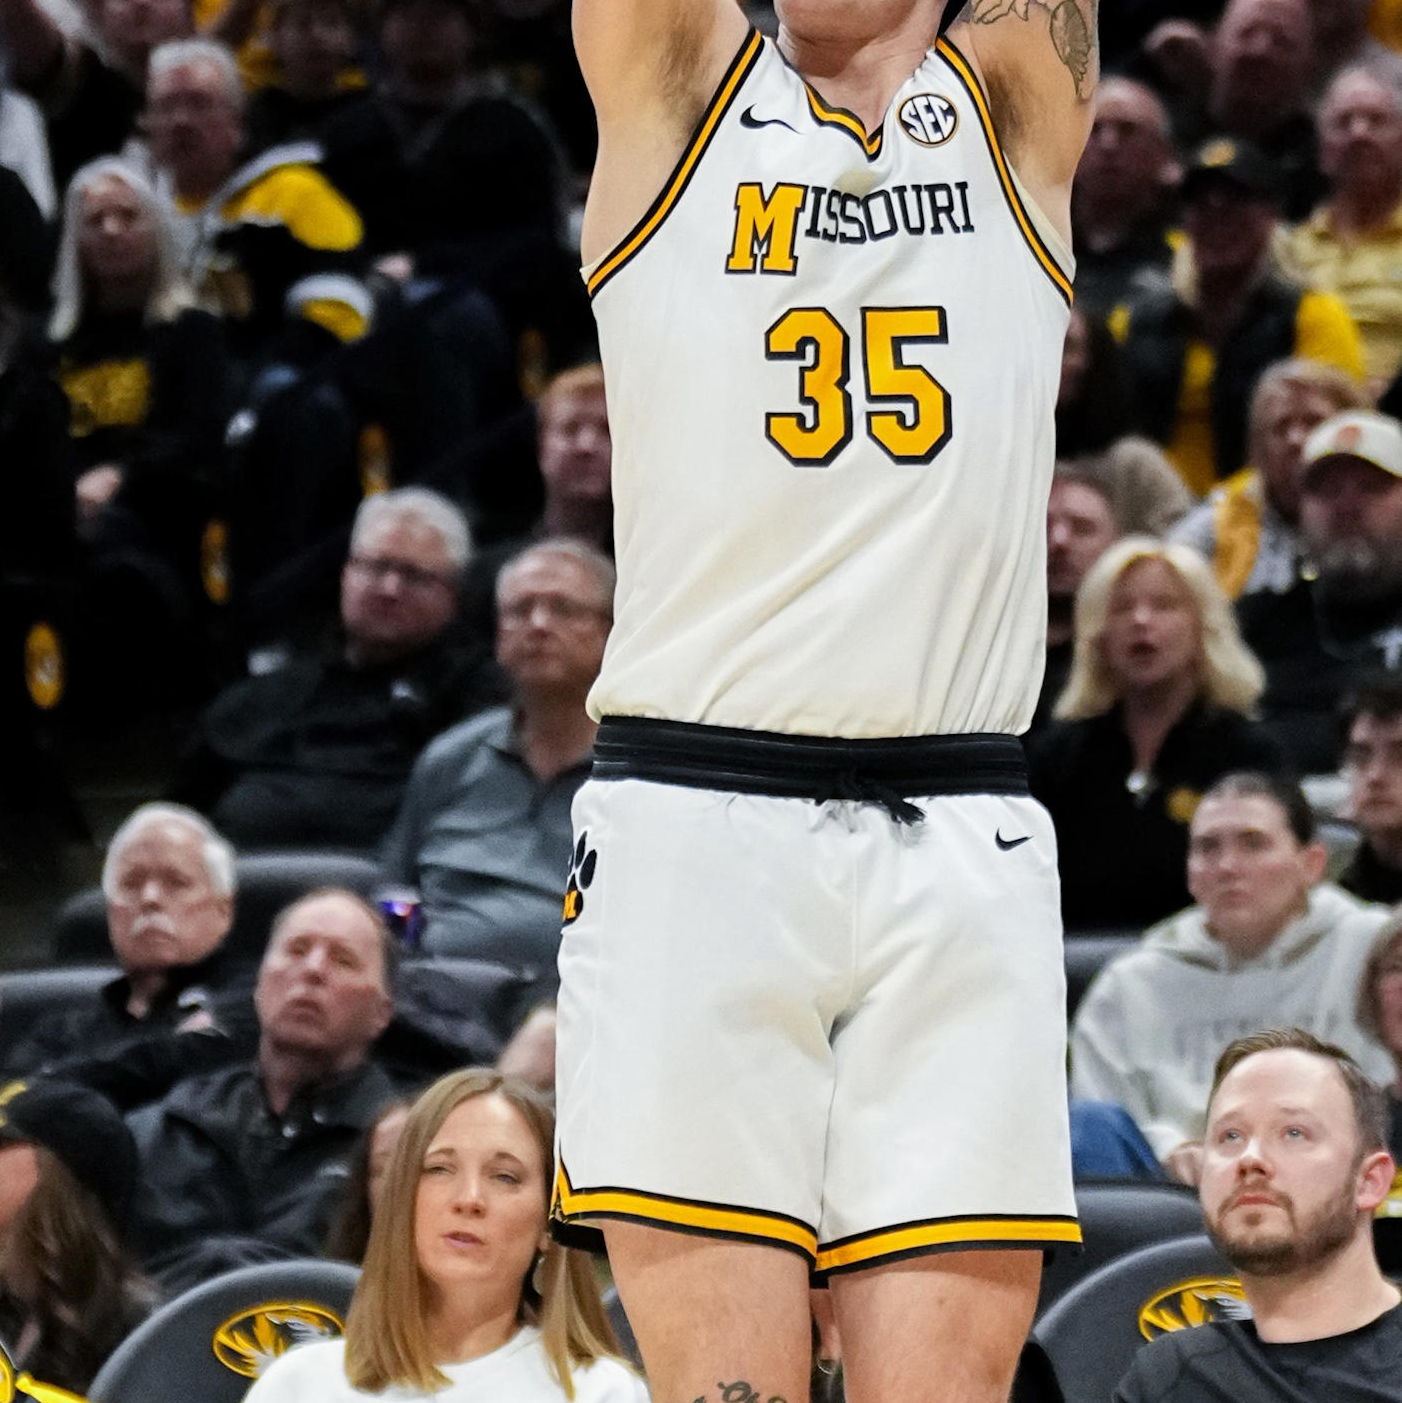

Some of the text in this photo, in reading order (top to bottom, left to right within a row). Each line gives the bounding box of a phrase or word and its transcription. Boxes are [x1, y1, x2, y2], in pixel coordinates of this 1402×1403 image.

[899, 94, 955, 144] SEC
[724, 181, 975, 277] MISSOURI
[764, 305, 953, 468] 35
